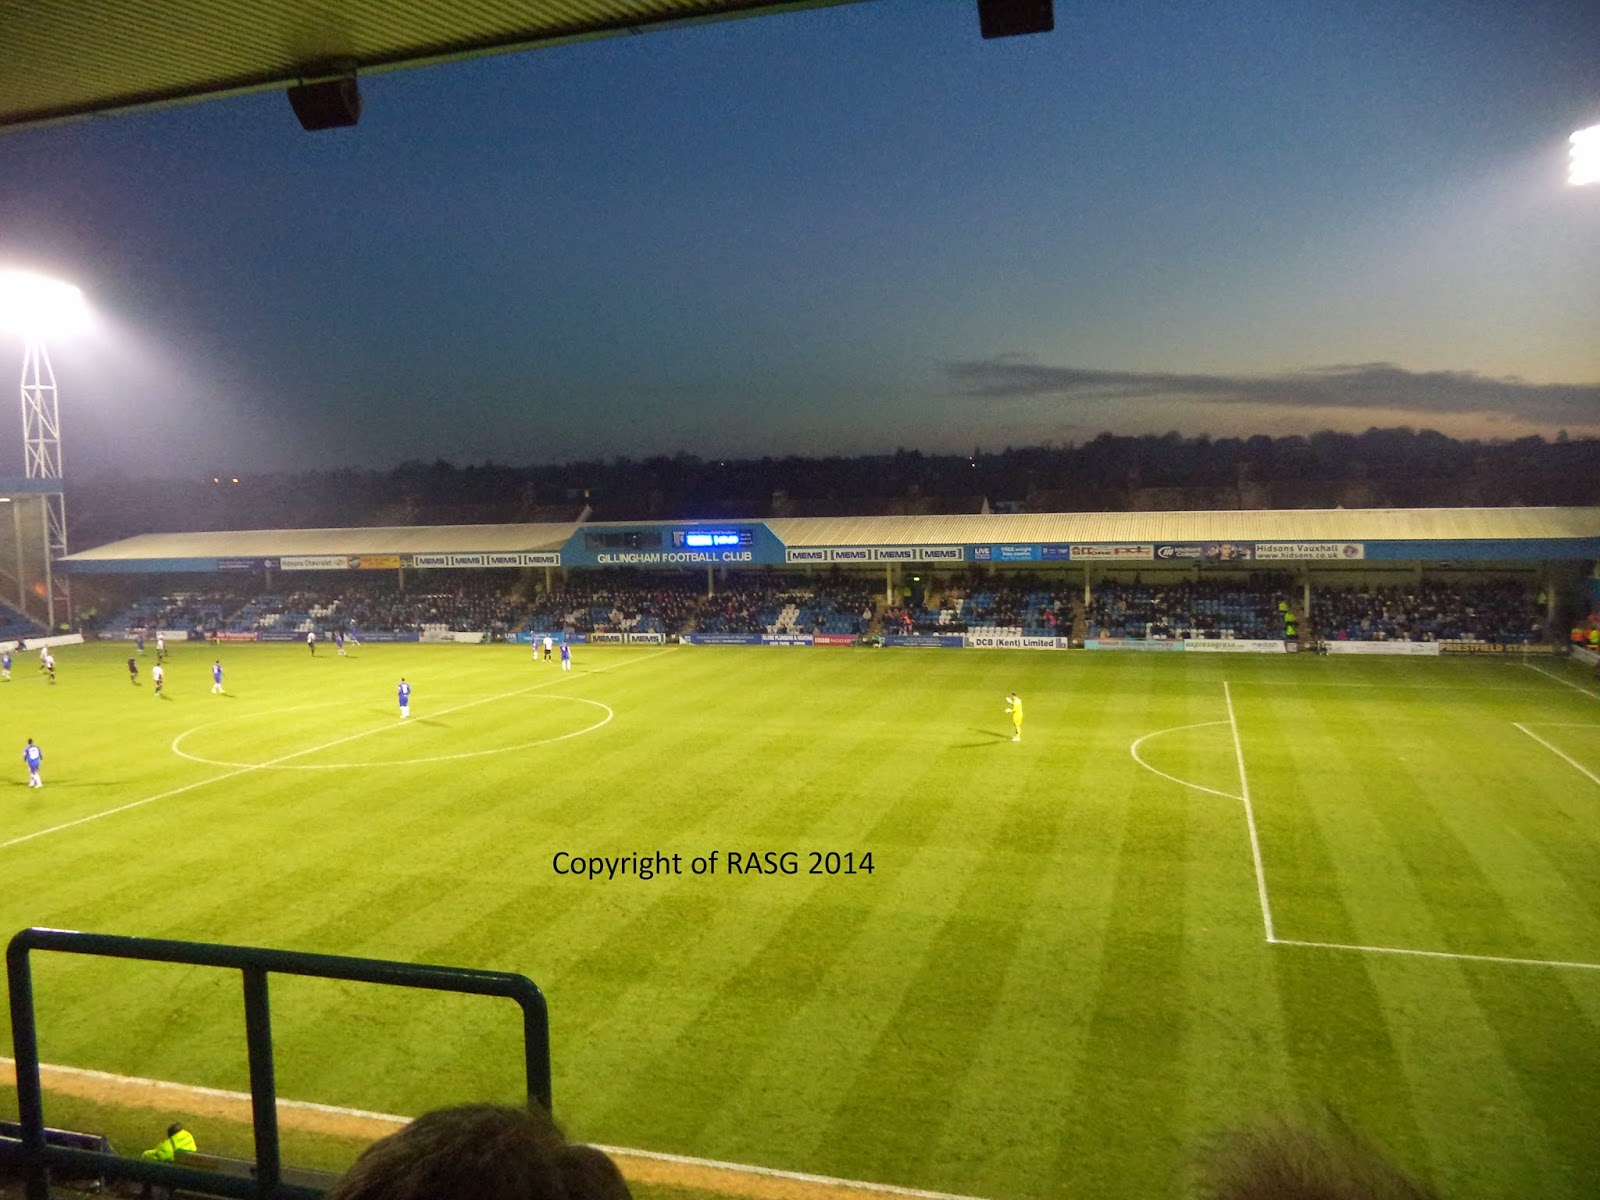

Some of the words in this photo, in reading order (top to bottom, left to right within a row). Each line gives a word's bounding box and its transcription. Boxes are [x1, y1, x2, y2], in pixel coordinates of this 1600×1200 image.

[1297, 544, 1338, 552] Vauxhall
[597, 553, 660, 563] GILLINGHAM
[662, 552, 719, 562] FOOTBALL
[722, 551, 753, 561] CLUB
[835, 551, 867, 559] MEMS
[924, 550, 957, 558] MEMS
[976, 638, 993, 646] DCB
[996, 638, 1020, 647] (Kent)
[1023, 639, 1054, 647] Limited
[1440, 643, 1503, 652] PRIESTFIELD
